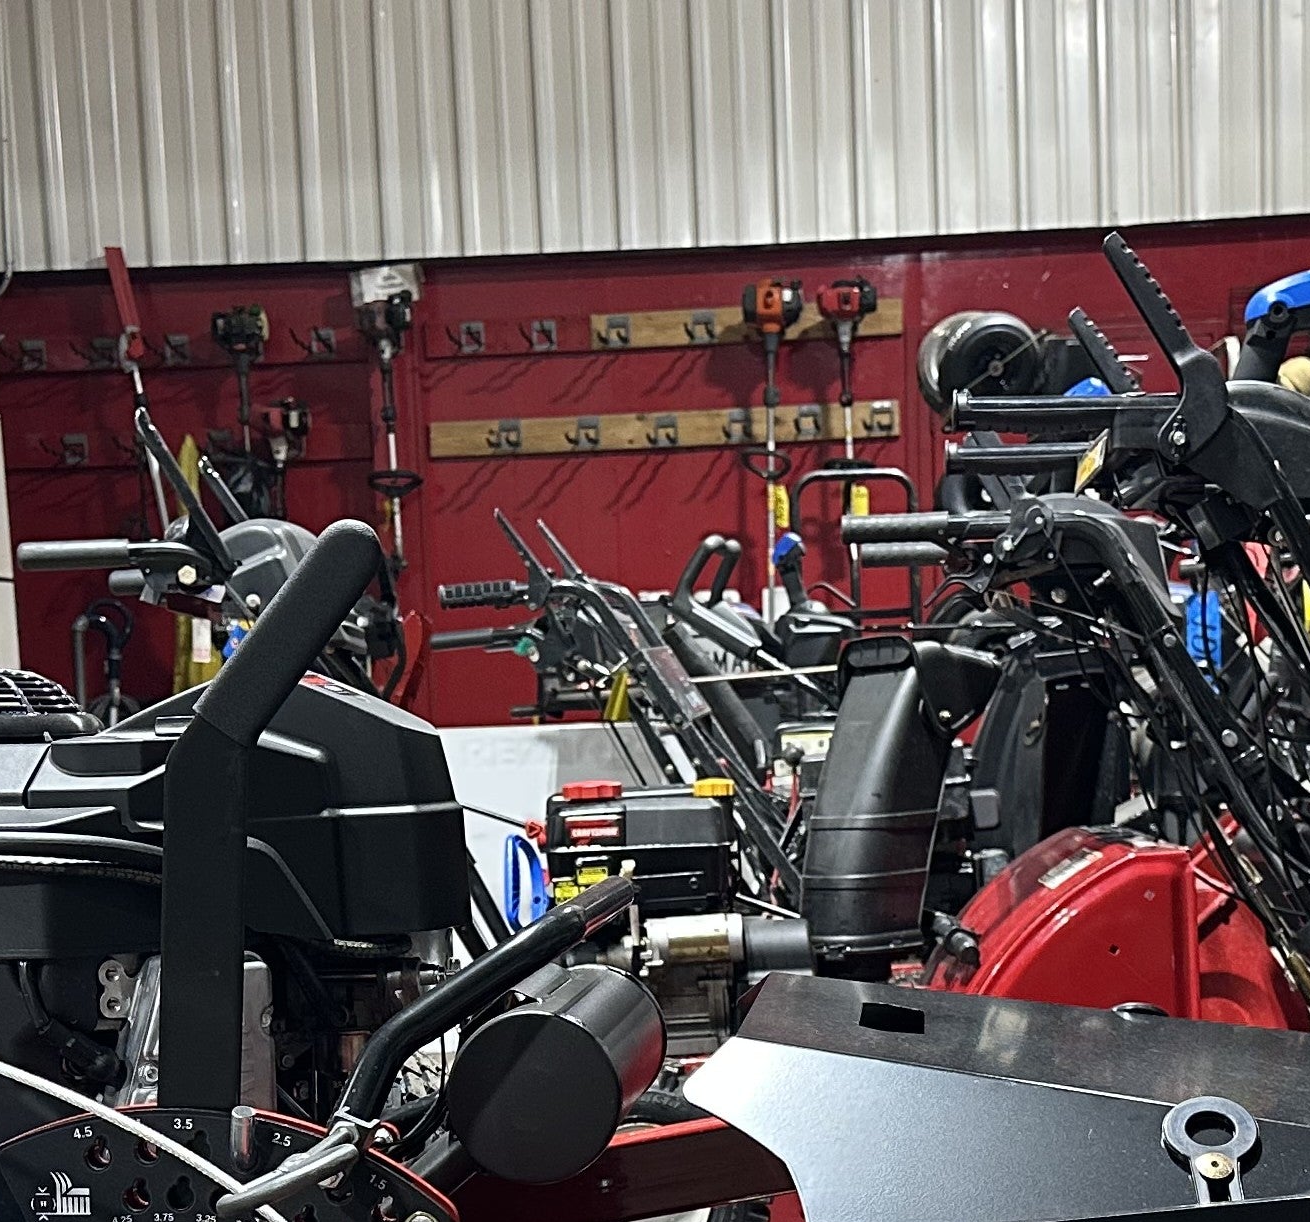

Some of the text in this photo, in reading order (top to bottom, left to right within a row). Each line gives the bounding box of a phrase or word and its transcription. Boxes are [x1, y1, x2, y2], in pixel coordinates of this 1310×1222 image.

[173, 1118, 193, 1131] 3.5
[73, 1126, 93, 1140] 4.5
[271, 1132, 291, 1148] 2.5
[153, 1212, 175, 1222] 3.75
